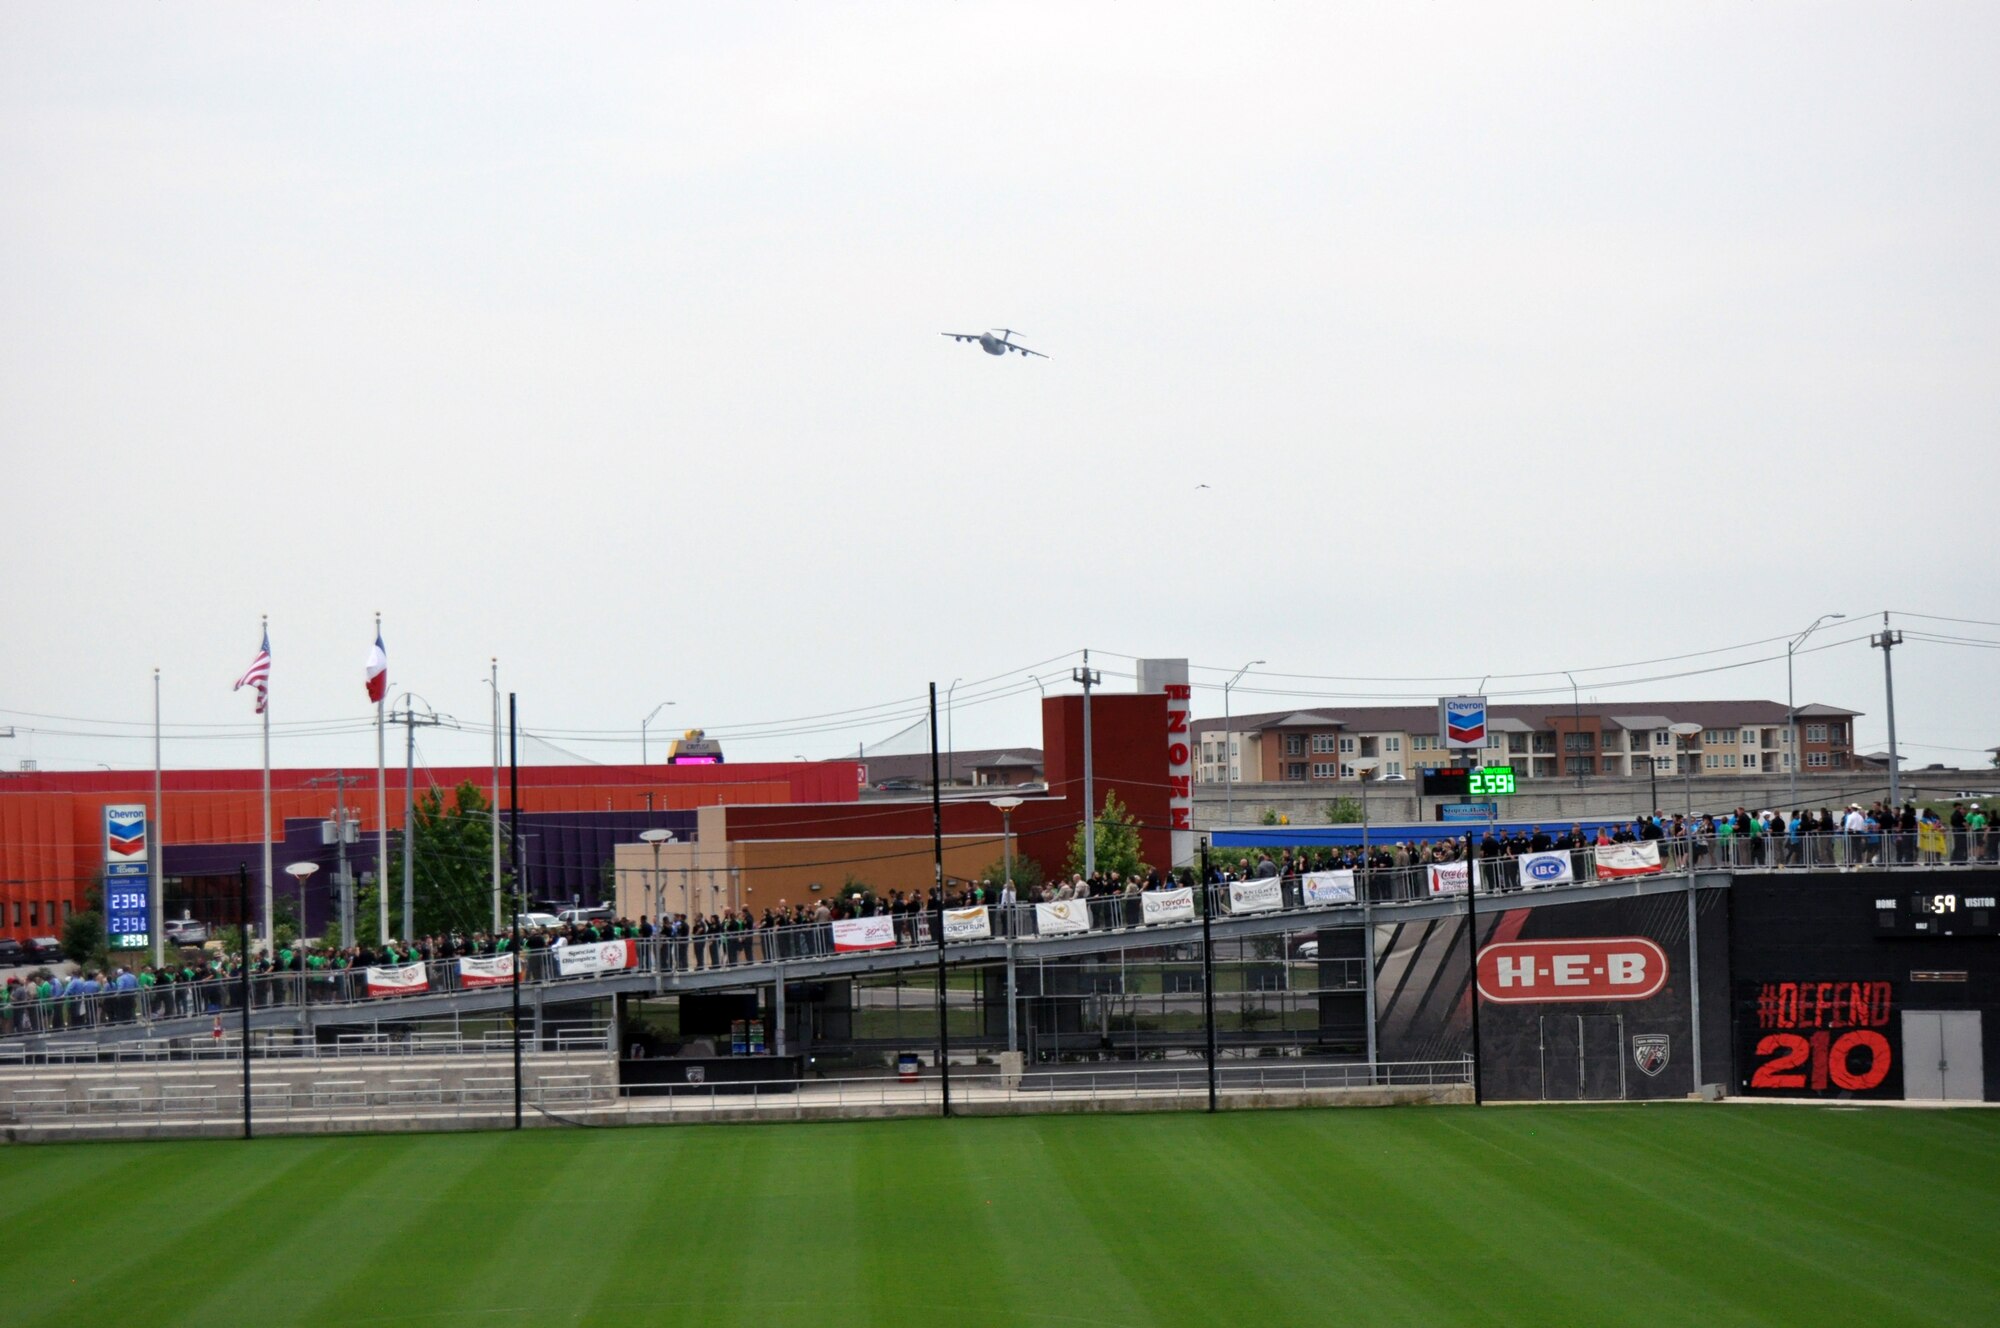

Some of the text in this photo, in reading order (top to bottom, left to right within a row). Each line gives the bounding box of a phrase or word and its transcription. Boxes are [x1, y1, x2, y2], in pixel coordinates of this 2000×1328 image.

[1164, 684, 1191, 700] THE
[1447, 701, 1484, 710] Chevron
[1168, 711, 1190, 830] ZONE
[109, 810, 144, 818] Chevron
[1161, 897, 1191, 907] TOYOTA
[1875, 899, 1896, 909] HOME
[1964, 897, 1996, 907] VISITOR
[969, 923, 985, 931] RUN
[568, 948, 595, 957] Special
[562, 955, 596, 964] Olympics
[1497, 953, 1647, 987] H-E-B
[1757, 981, 1892, 1028] #DEFEND
[1751, 1030, 1892, 1091] 210
